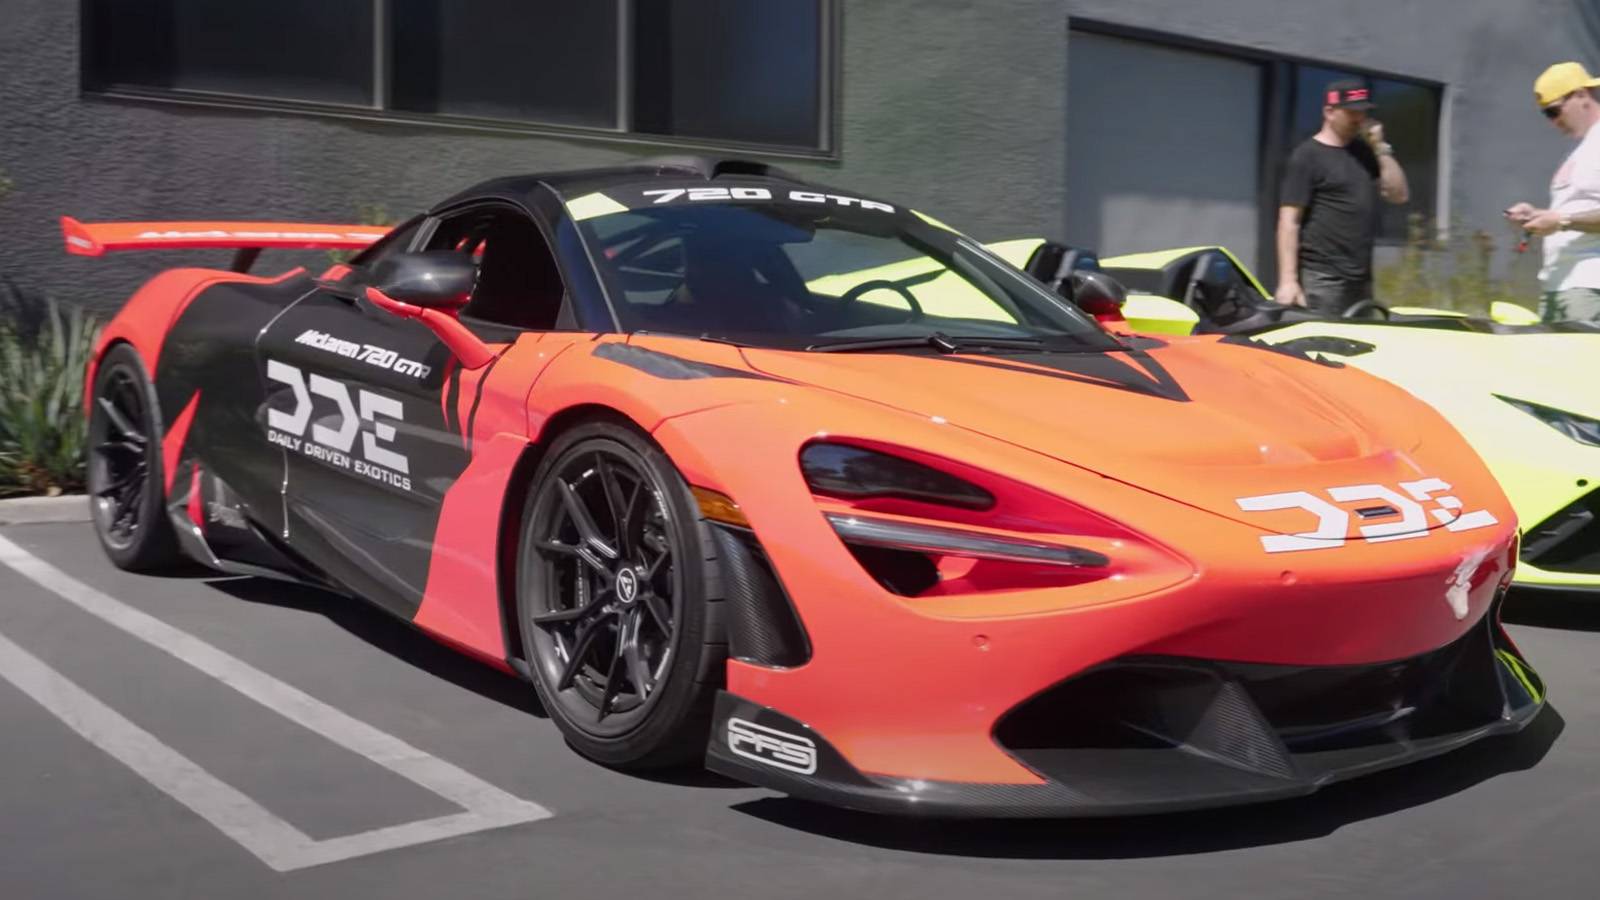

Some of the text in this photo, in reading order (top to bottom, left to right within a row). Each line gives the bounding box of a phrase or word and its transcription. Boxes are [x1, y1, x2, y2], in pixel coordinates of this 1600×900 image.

[643, 187, 895, 214] 720 GTR
[295, 329, 431, 379] McLaren 720 GTR
[267, 359, 409, 474] DDE
[267, 430, 412, 491] DAILY DRIVEN EXOTICS
[1235, 478, 1498, 553] DDE
